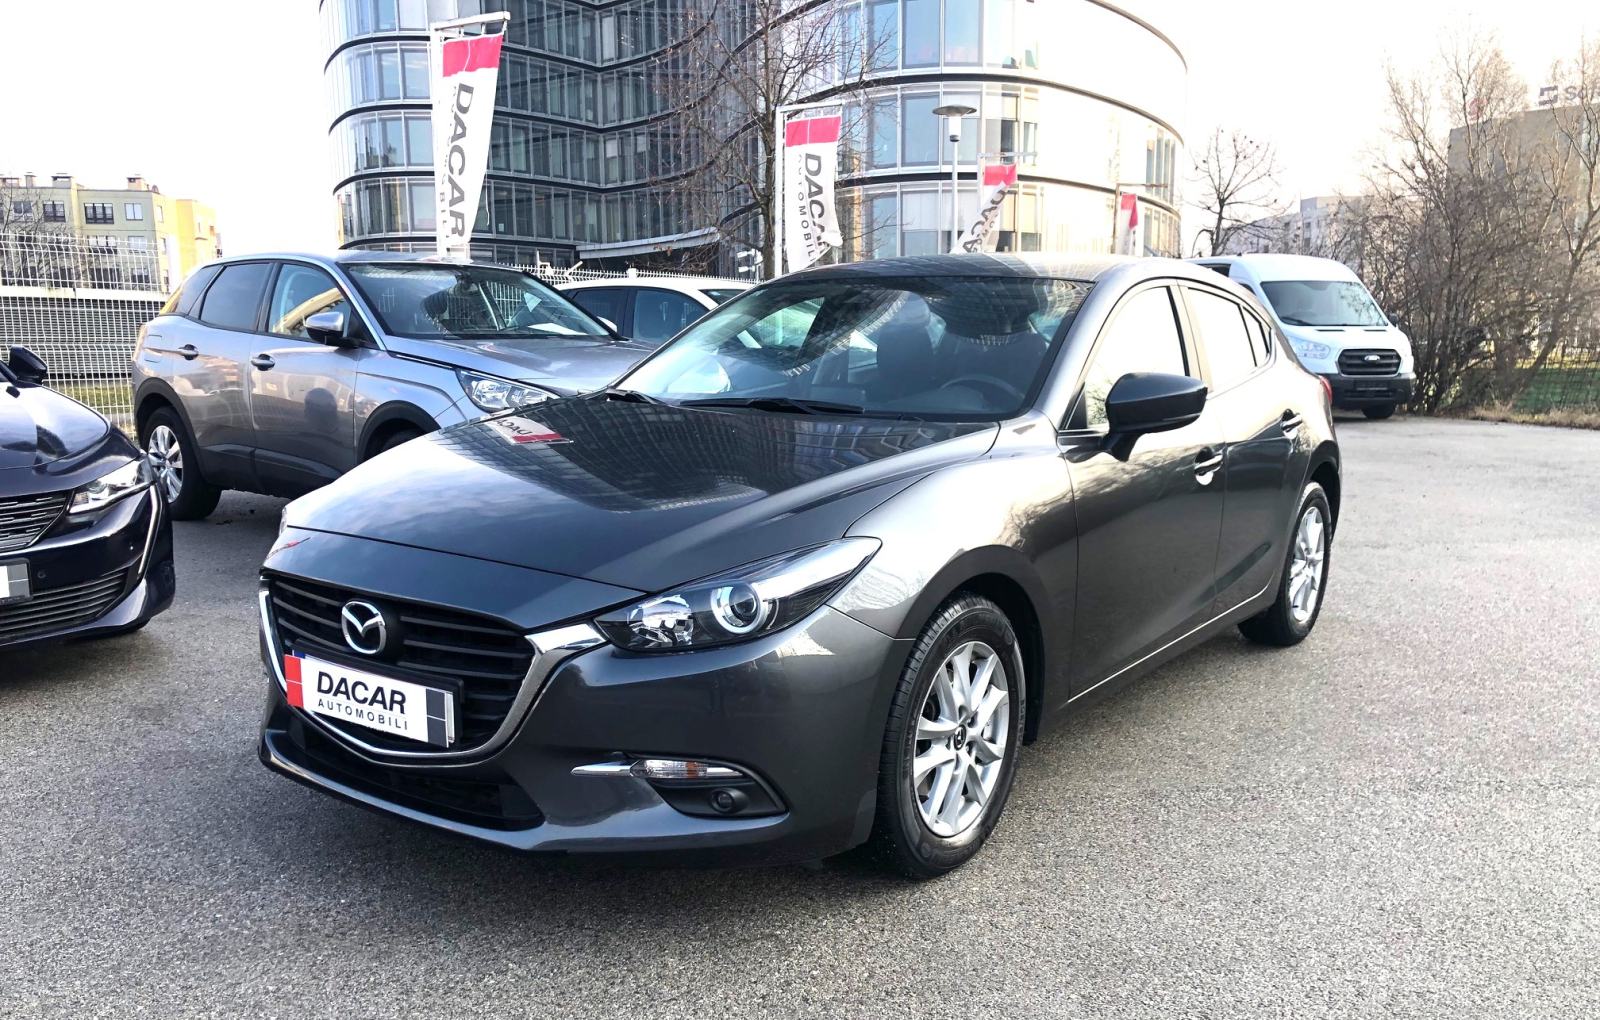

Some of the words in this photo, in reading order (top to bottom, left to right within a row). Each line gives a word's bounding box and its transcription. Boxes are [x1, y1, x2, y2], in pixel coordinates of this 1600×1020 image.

[448, 83, 474, 237] DACAR
[317, 671, 406, 714] DACAR
[318, 699, 408, 730] AUTOMOBILI
